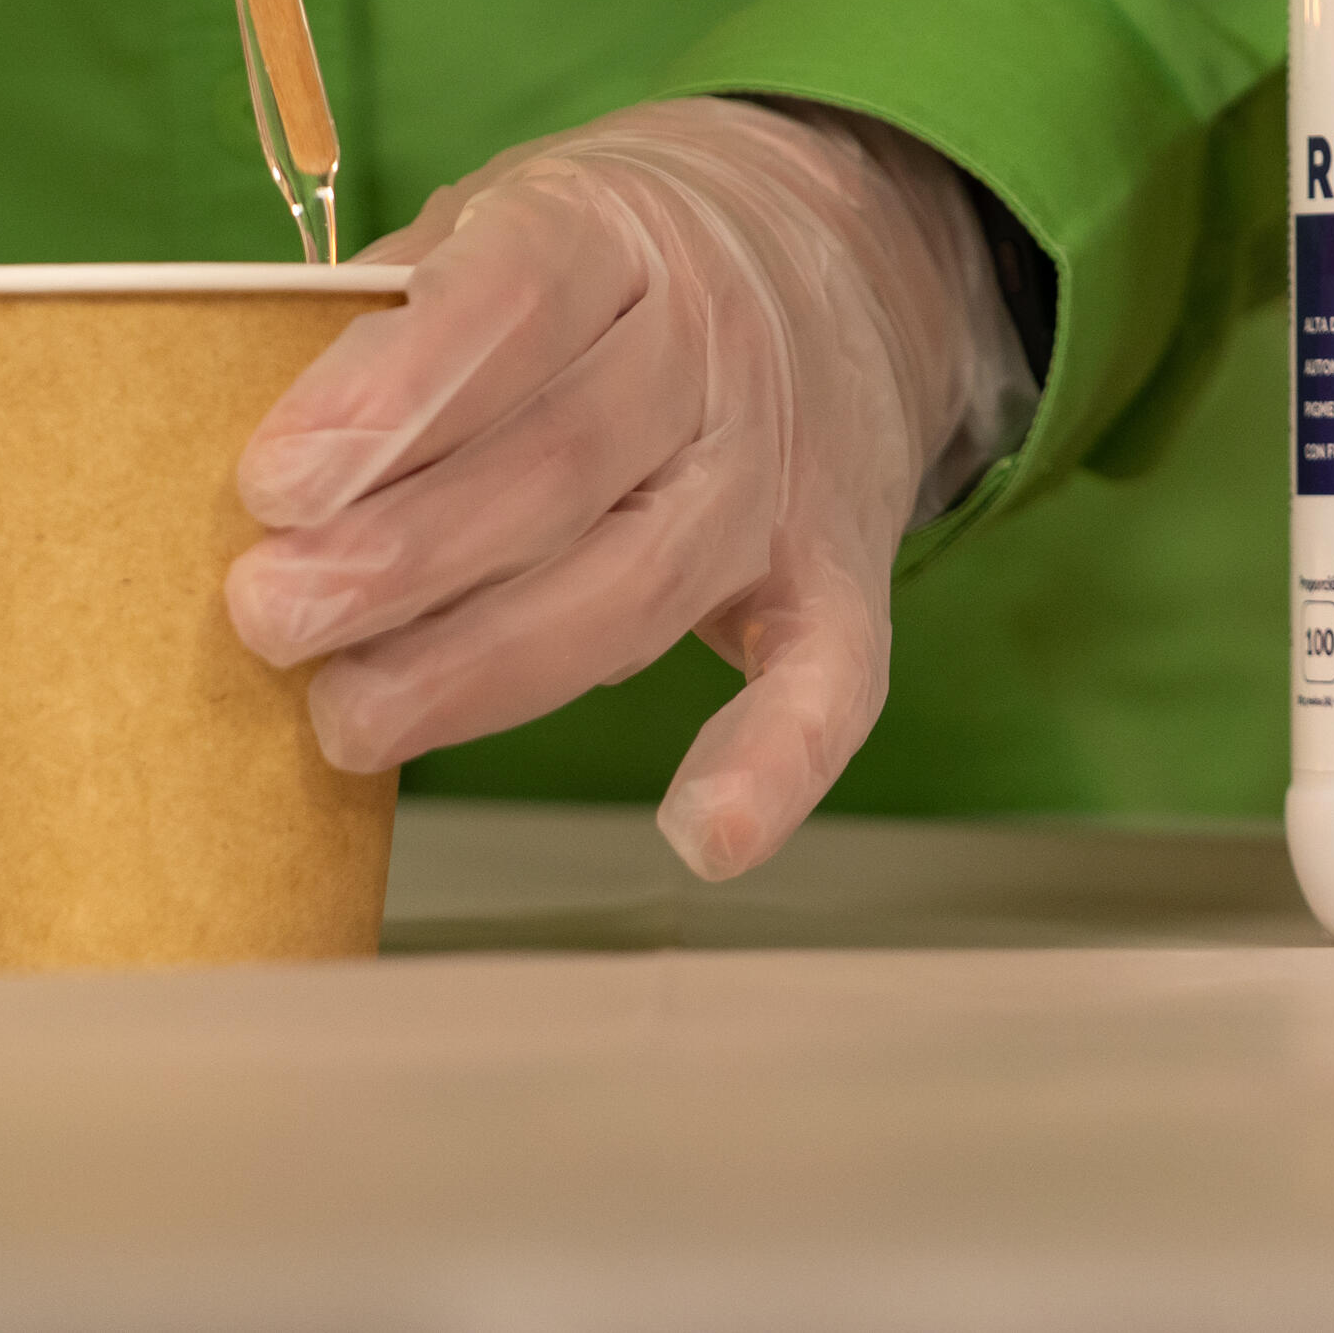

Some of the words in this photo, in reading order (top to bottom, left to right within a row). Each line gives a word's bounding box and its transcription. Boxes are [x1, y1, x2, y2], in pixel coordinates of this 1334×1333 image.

[1304, 316, 1328, 333] ALTA
[1304, 443, 1325, 460] CON
[1305, 628, 1334, 657] 100
